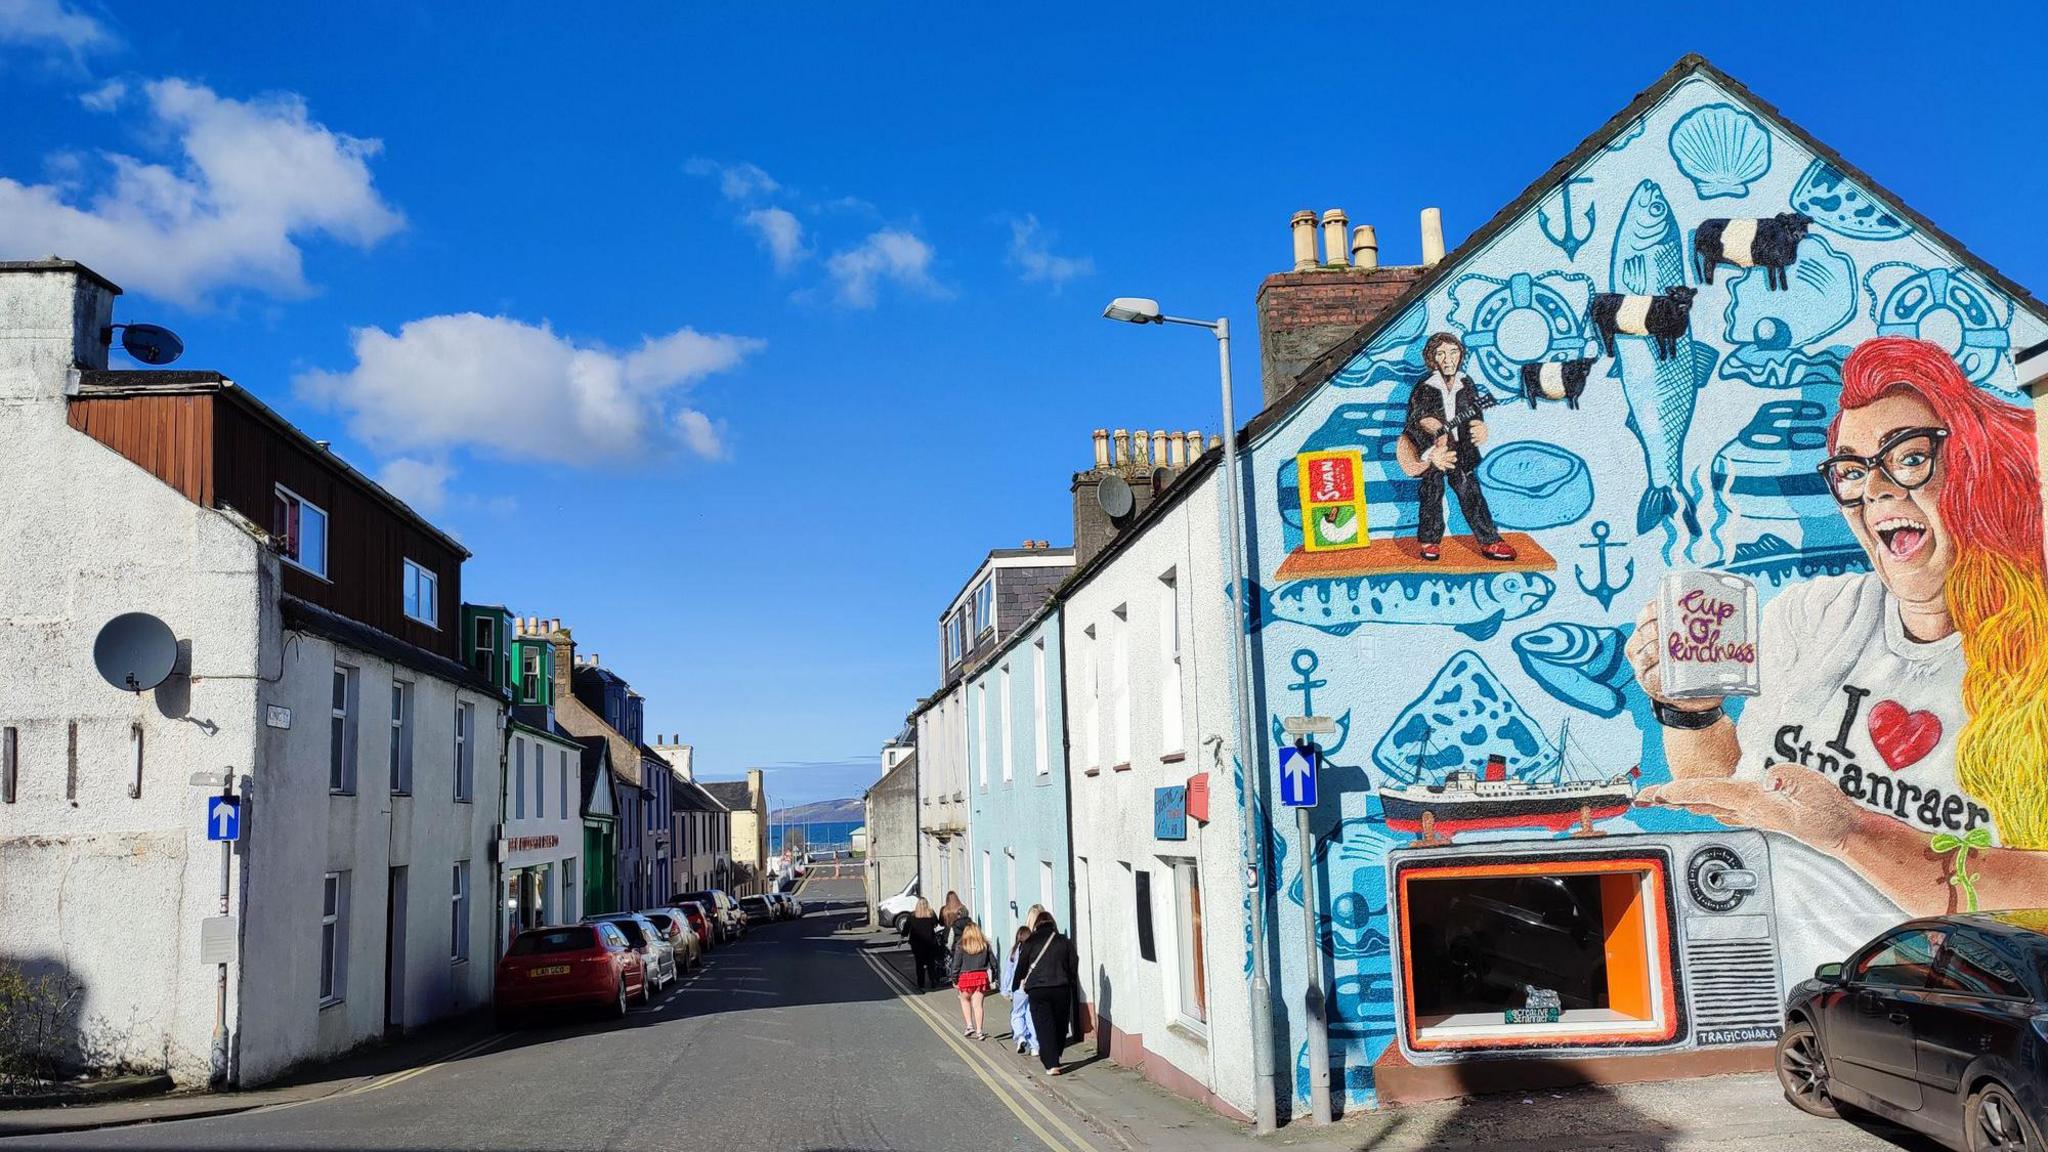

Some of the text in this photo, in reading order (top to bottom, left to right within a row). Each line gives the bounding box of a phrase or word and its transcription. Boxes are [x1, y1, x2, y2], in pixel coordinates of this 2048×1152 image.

[1678, 589, 1735, 626] Cup
[1668, 629, 1755, 664] kindness
[1825, 684, 1871, 760] I
[1764, 724, 1990, 831] Stranraer
